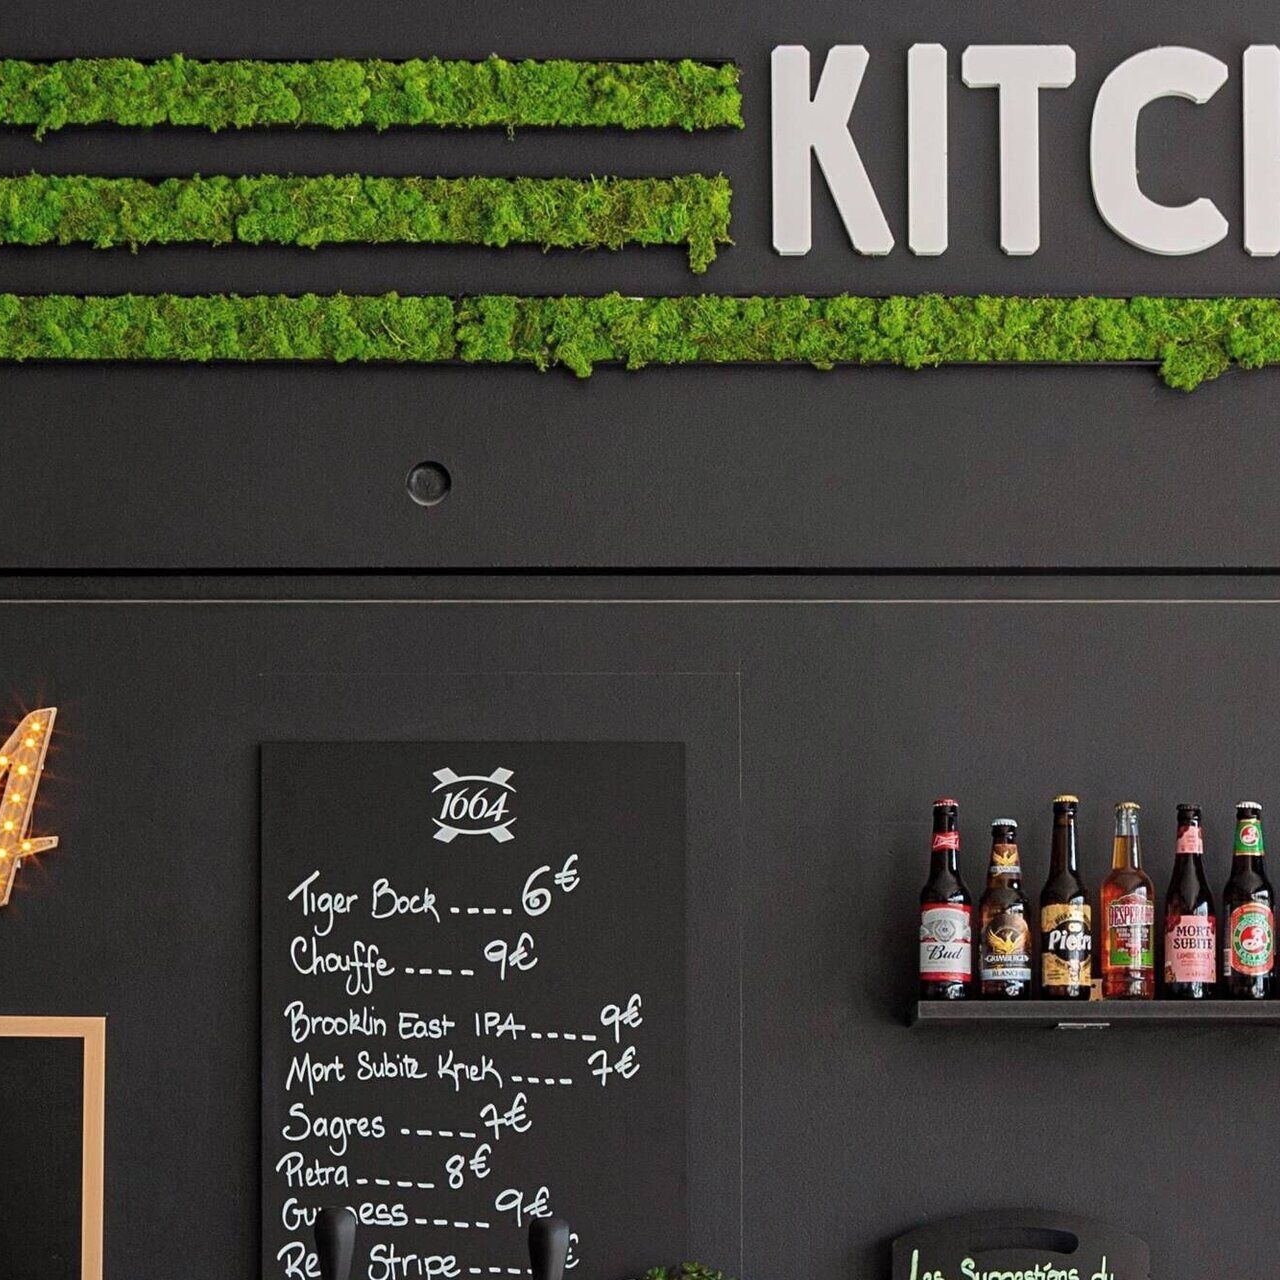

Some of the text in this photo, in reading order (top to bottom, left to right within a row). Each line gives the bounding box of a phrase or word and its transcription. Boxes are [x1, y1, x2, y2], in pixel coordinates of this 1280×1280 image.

[439, 787, 509, 822] 1664
[288, 870, 358, 936] Tiger
[371, 878, 441, 923] Bock
[1173, 938, 1213, 950] SUBITE
[1176, 925, 1211, 937] MORT
[290, 937, 395, 995] Chouffe
[926, 944, 964, 961] Bud
[284, 1000, 387, 1043] Brooklin
[399, 1011, 456, 1040] East
[475, 1011, 526, 1039] IPA
[285, 1052, 345, 1095] Mort
[282, 1103, 386, 1156] Sagres
[276, 1152, 349, 1188] Pietra
